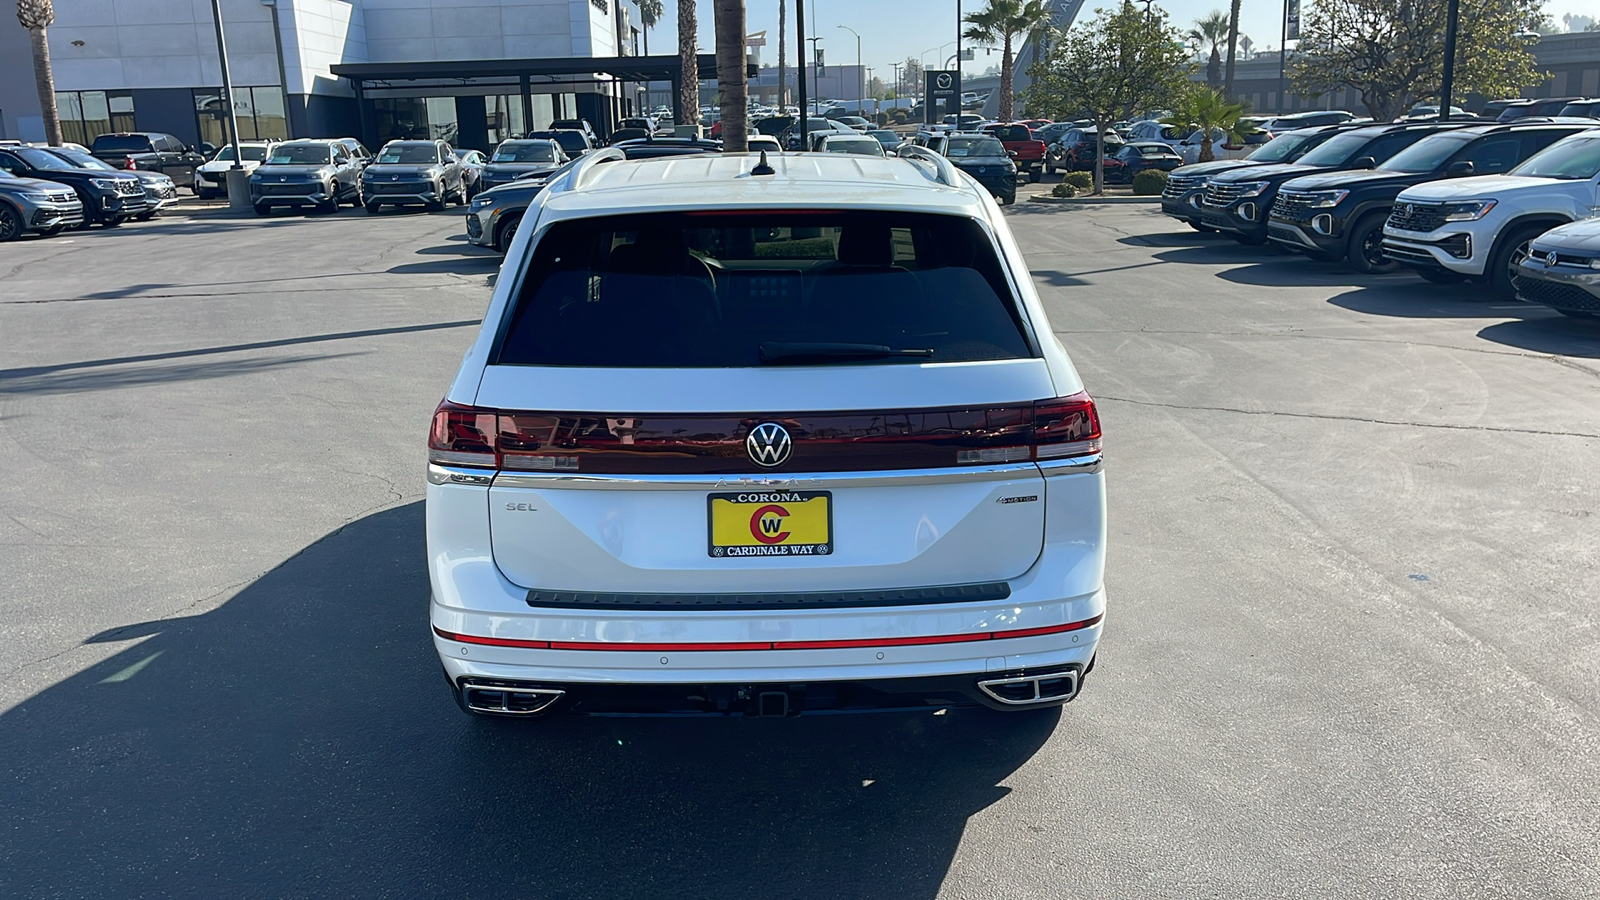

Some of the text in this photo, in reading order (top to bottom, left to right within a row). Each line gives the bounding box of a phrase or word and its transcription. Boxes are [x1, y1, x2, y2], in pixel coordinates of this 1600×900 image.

[738, 493, 801, 503] CORONA
[506, 502, 538, 512] SEL
[727, 546, 788, 556] CARDINALE
[791, 545, 815, 555] WAY
